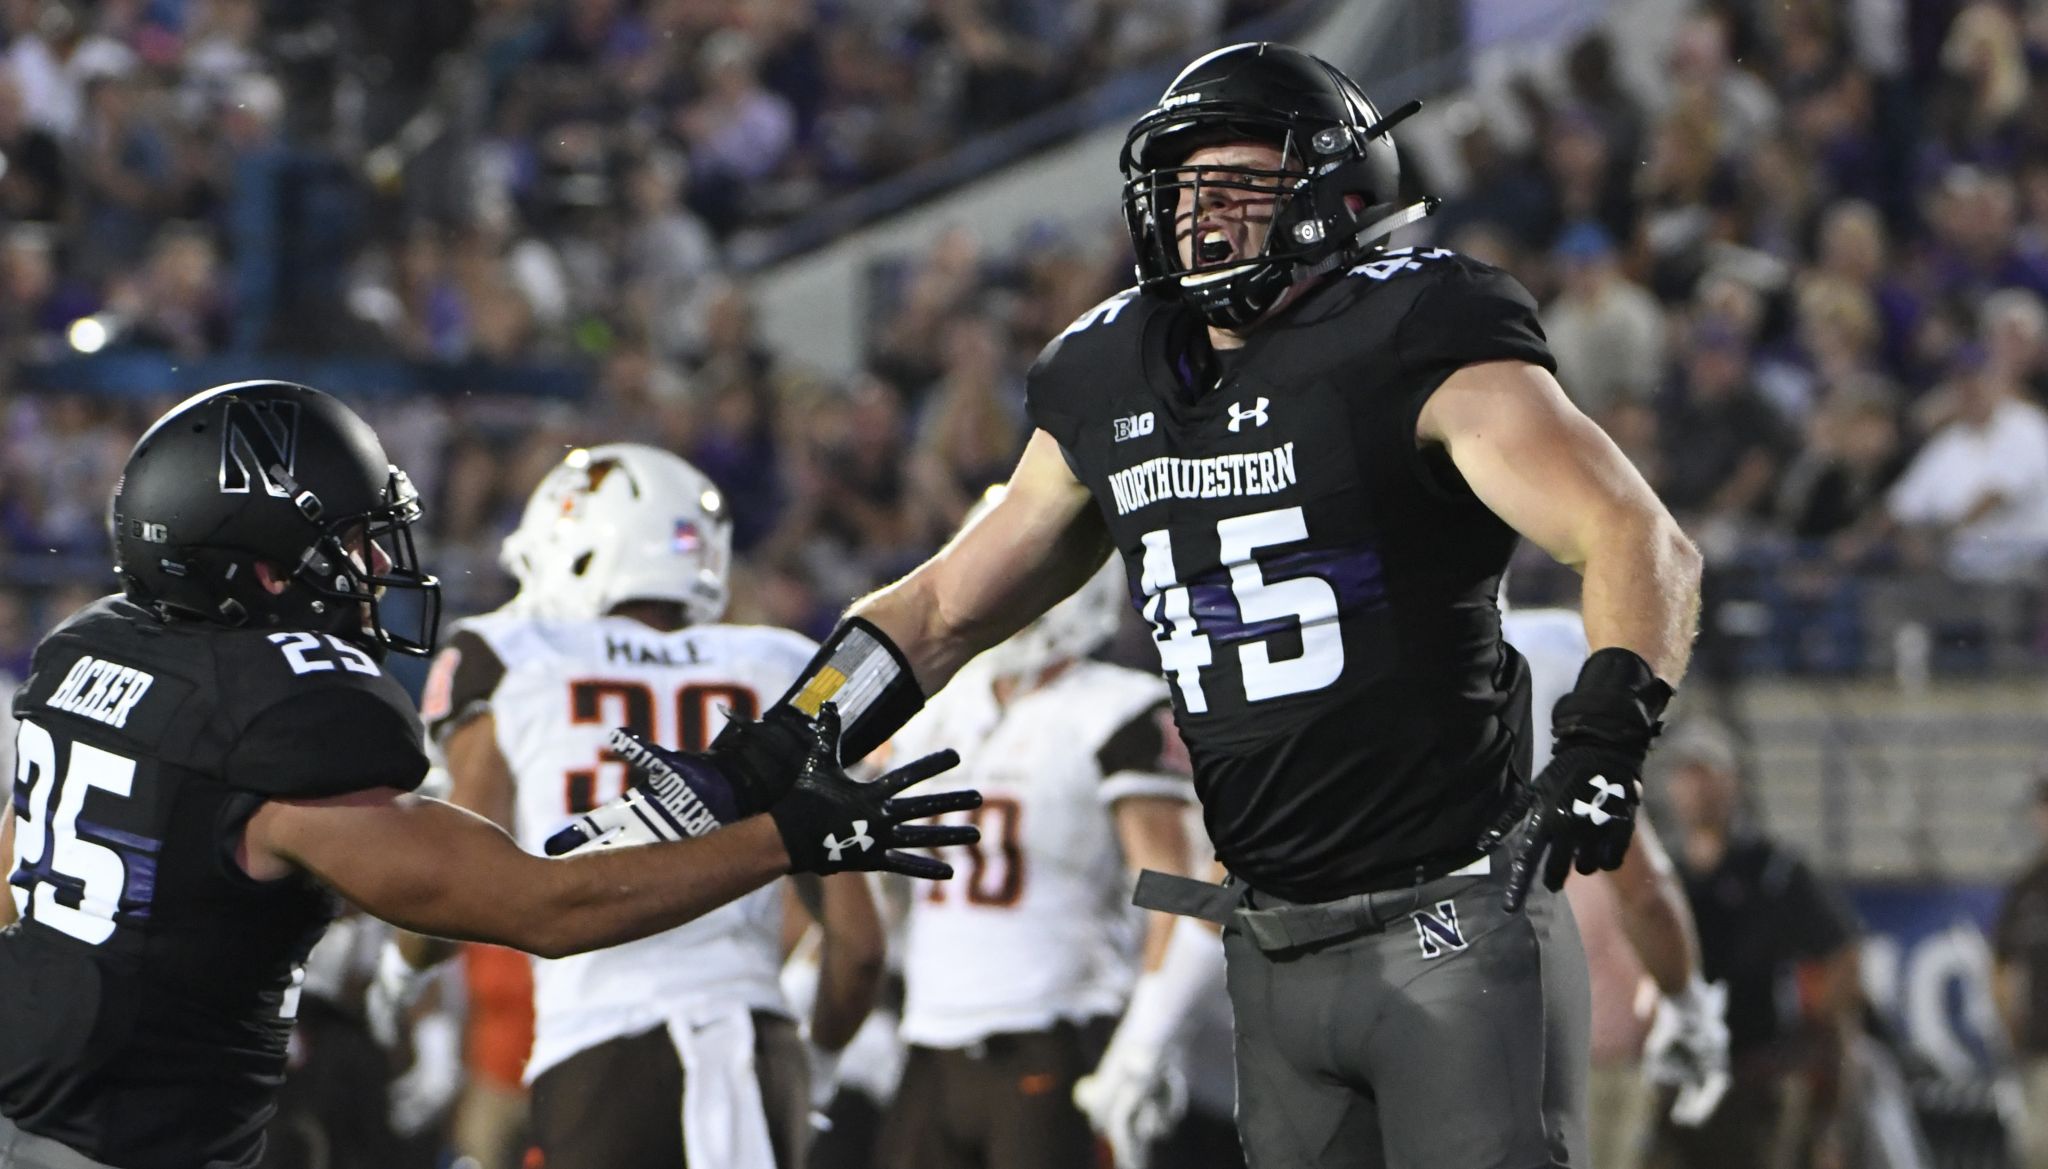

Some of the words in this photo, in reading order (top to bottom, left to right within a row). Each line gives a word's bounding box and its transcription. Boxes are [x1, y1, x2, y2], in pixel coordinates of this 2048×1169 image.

[219, 399, 299, 498] N
[1108, 442, 1297, 515] NORTHWESTERN
[1141, 506, 1345, 714] 45
[265, 631, 382, 677] 25
[606, 634, 713, 668] HALE
[46, 655, 154, 729] ACKER
[6, 718, 136, 945] 25
[1408, 899, 1469, 959] N
